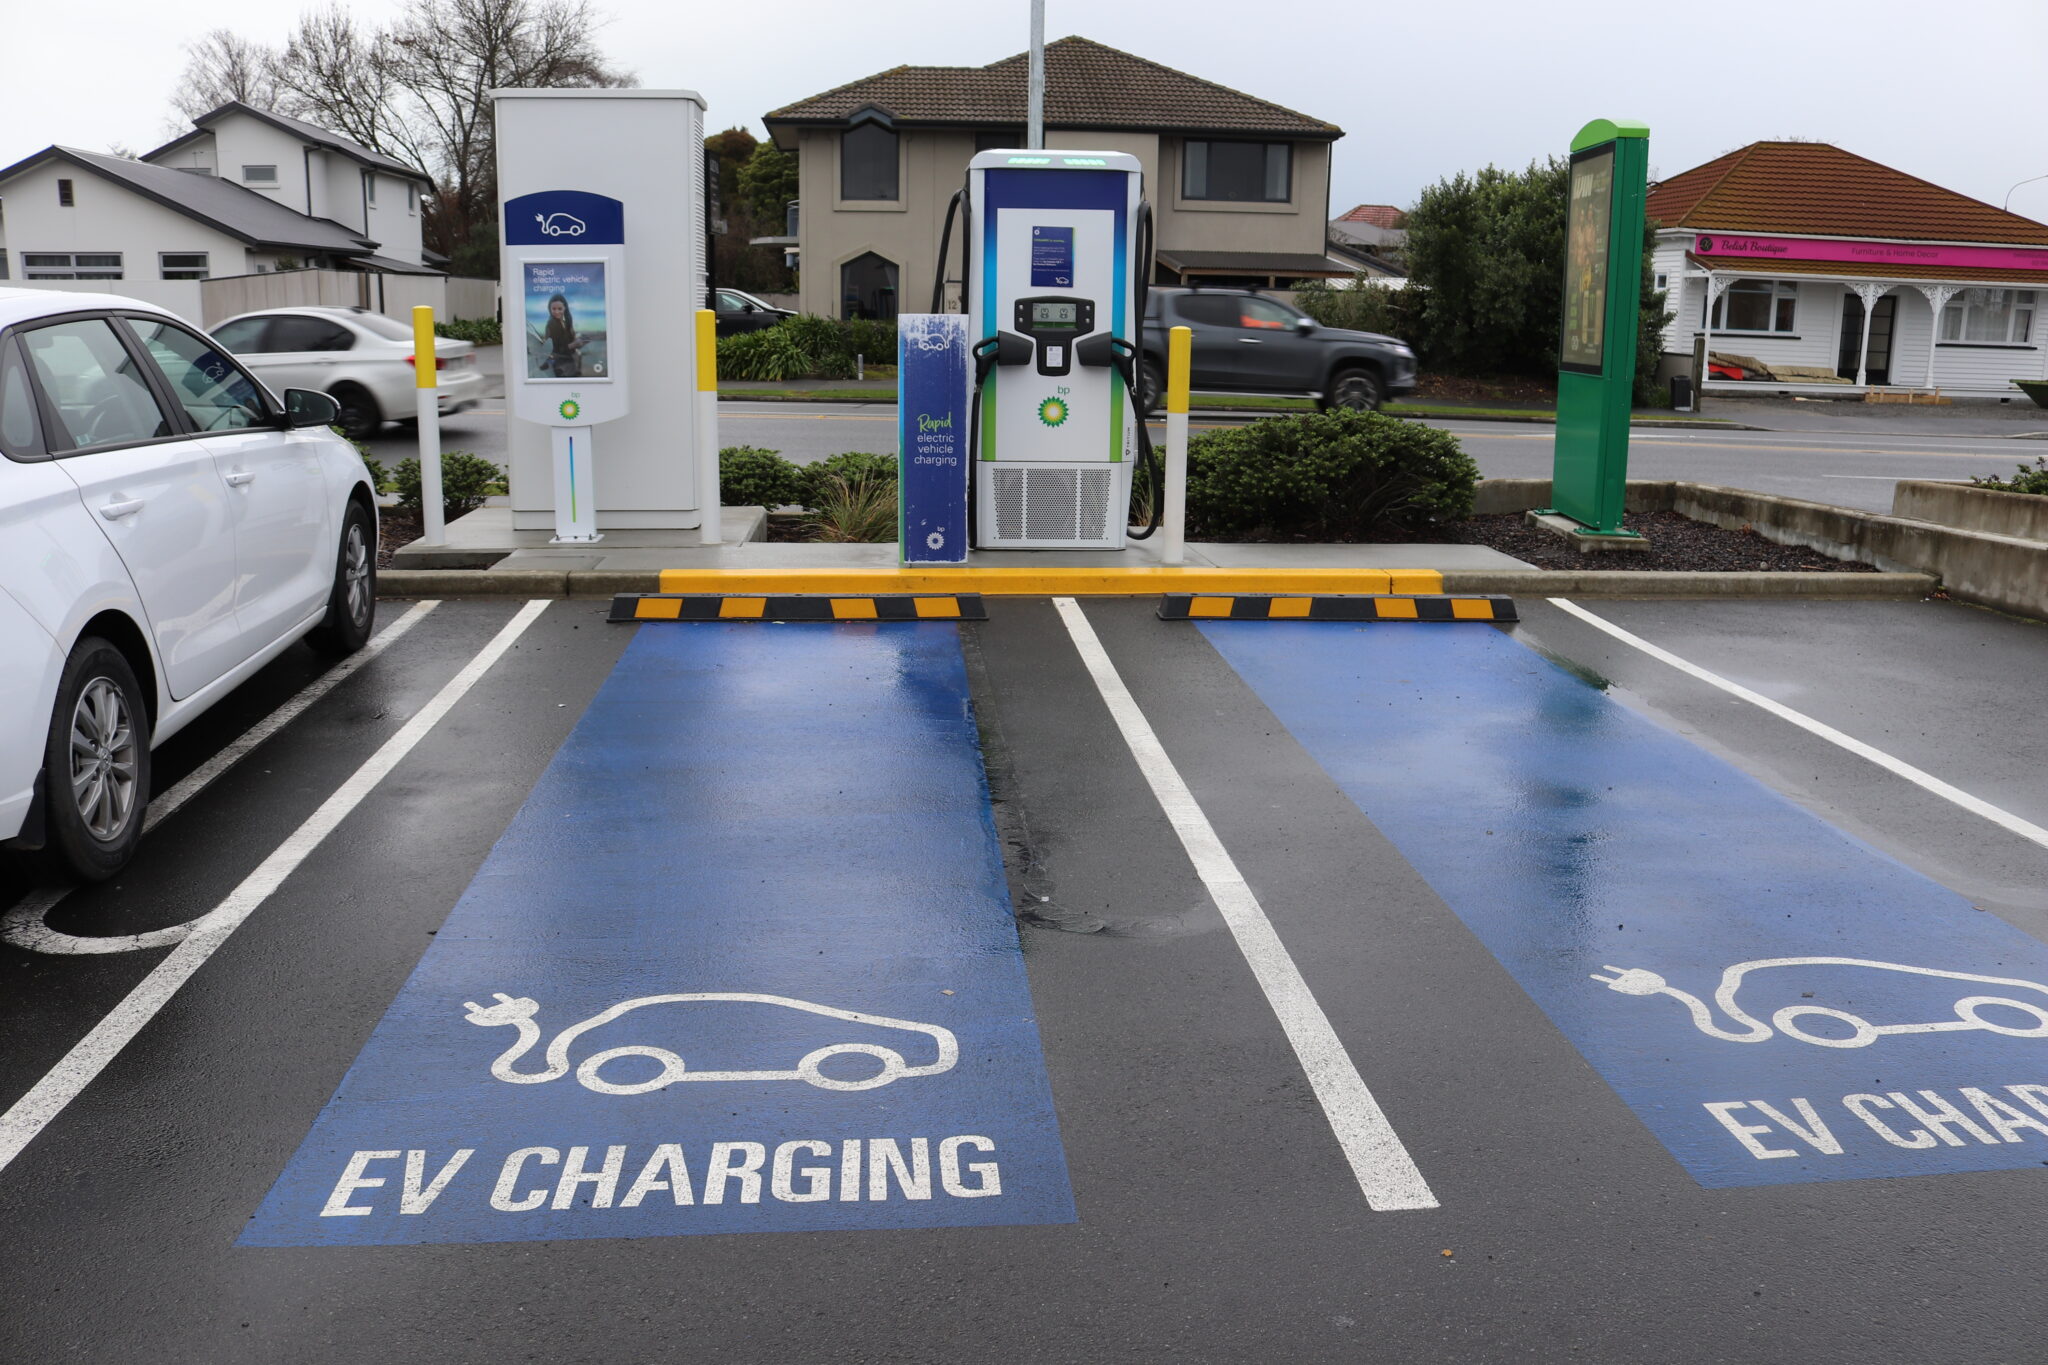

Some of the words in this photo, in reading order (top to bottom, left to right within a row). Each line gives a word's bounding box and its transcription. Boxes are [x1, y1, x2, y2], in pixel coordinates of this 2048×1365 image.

[1750, 240, 1788, 254] Boutique
[1851, 247, 1884, 256] Furniture
[1893, 249, 1915, 258] Home
[532, 268, 554, 277] Rapid
[533, 276, 561, 284] electric
[562, 275, 589, 283] vehicle
[533, 284, 565, 293] charging
[1057, 385, 1070, 396] bp
[917, 411, 952, 433] Rapid
[917, 433, 955, 443] electric
[918, 444, 954, 454] vehicle
[914, 455, 957, 467] charging
[1702, 1097, 1845, 1160] EV
[319, 1149, 476, 1217] EV
[490, 1135, 1002, 1212] CHARGING
